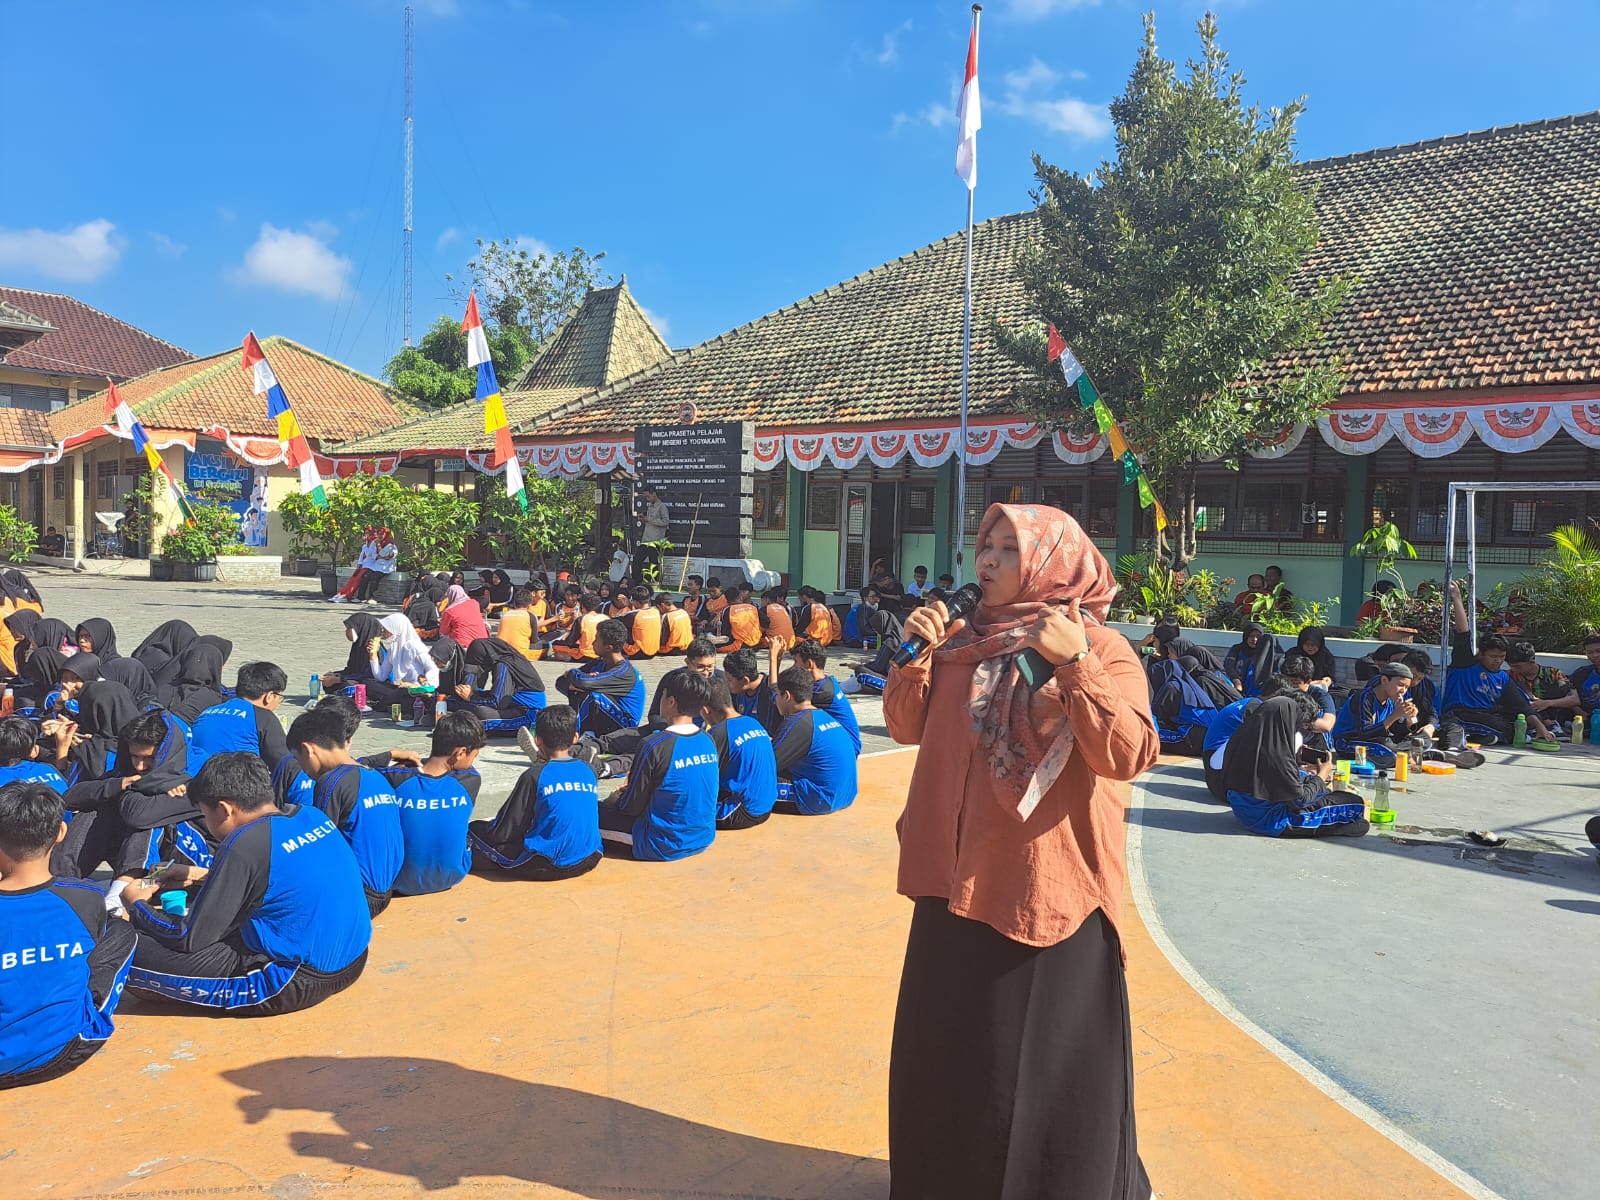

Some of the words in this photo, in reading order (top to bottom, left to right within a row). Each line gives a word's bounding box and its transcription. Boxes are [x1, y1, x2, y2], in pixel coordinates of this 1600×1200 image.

[668, 429, 696, 437] PRASETIA
[697, 428, 723, 436] PELAJAR
[689, 437, 727, 445] YOGYAKARTA
[187, 451, 227, 469] AKSI
[189, 465, 249, 482] BERGIZI
